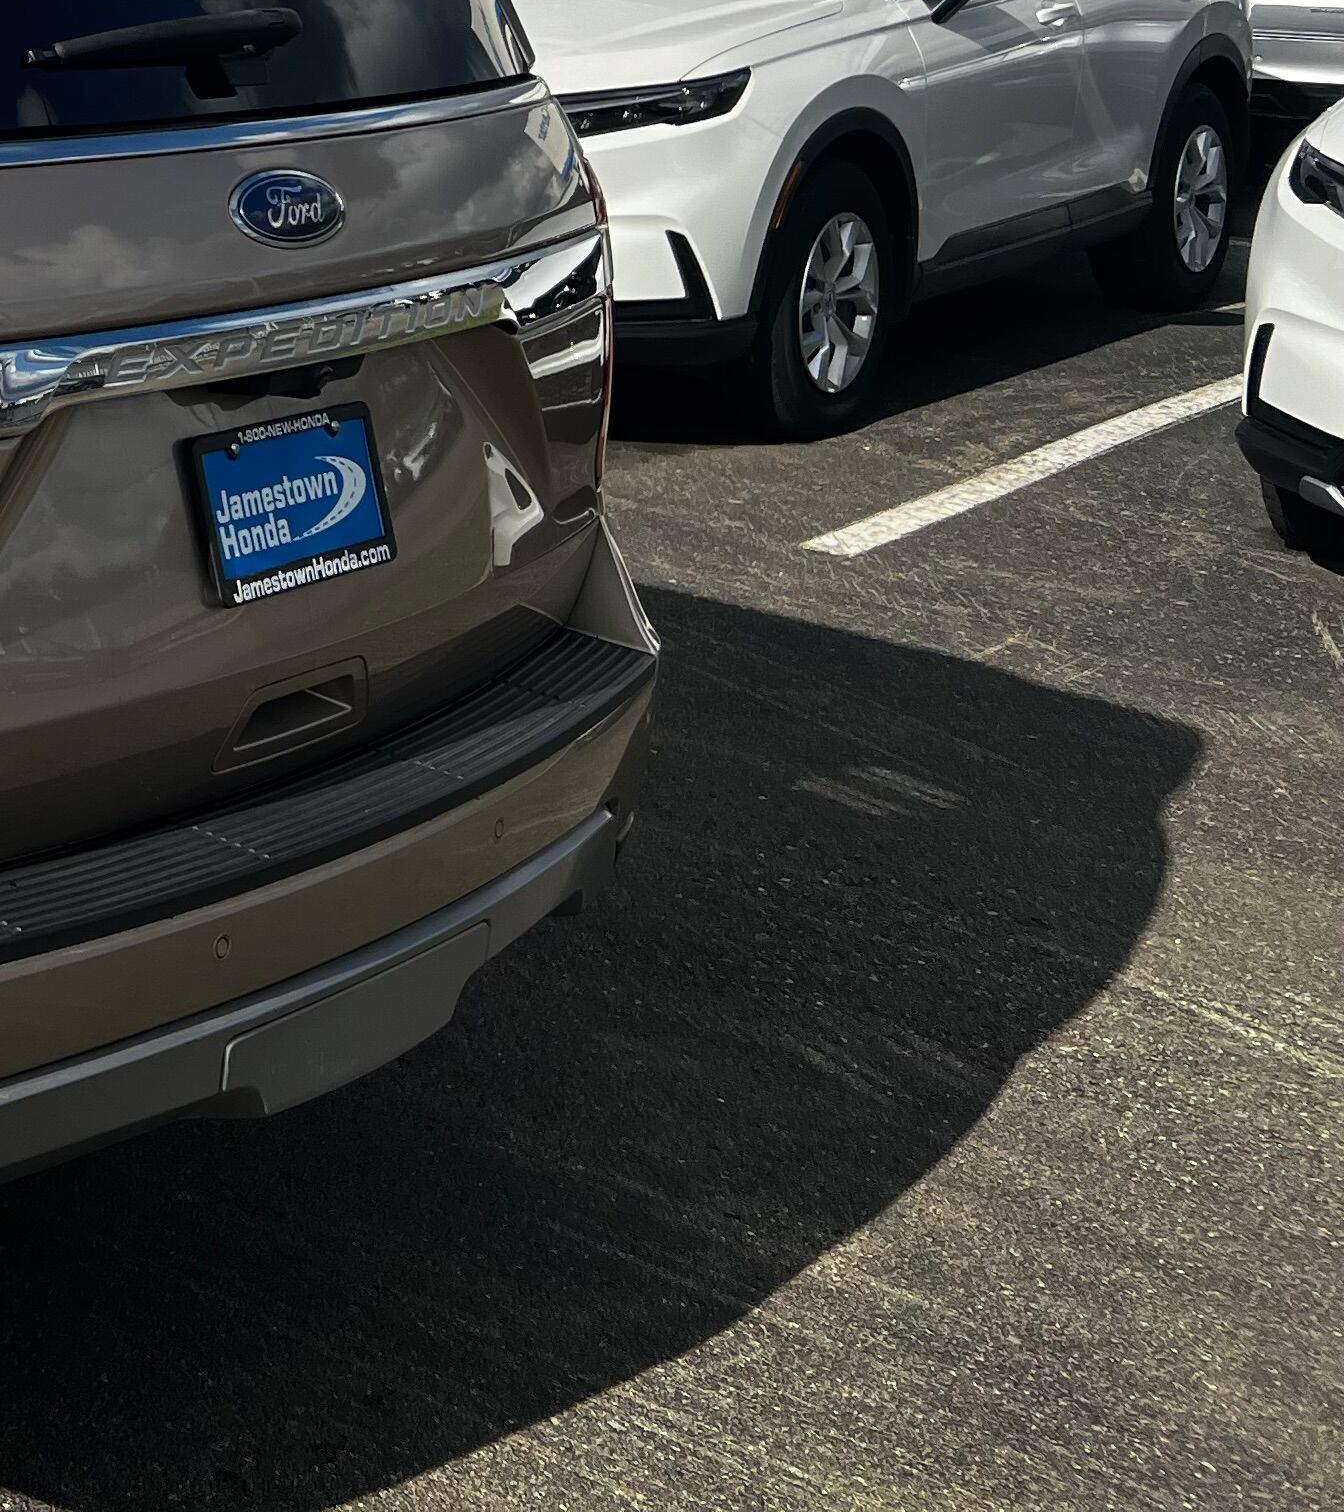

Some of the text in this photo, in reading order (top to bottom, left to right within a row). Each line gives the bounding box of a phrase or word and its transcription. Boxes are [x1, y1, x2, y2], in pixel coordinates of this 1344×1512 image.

[266, 185, 326, 228] Ford
[103, 285, 485, 387] EXPEDITION
[237, 413, 331, 443] 1-800-NEW-HONDA
[216, 471, 338, 523] Jamestown
[219, 513, 291, 559] Honda
[233, 544, 391, 603] JamestownHonda.com
